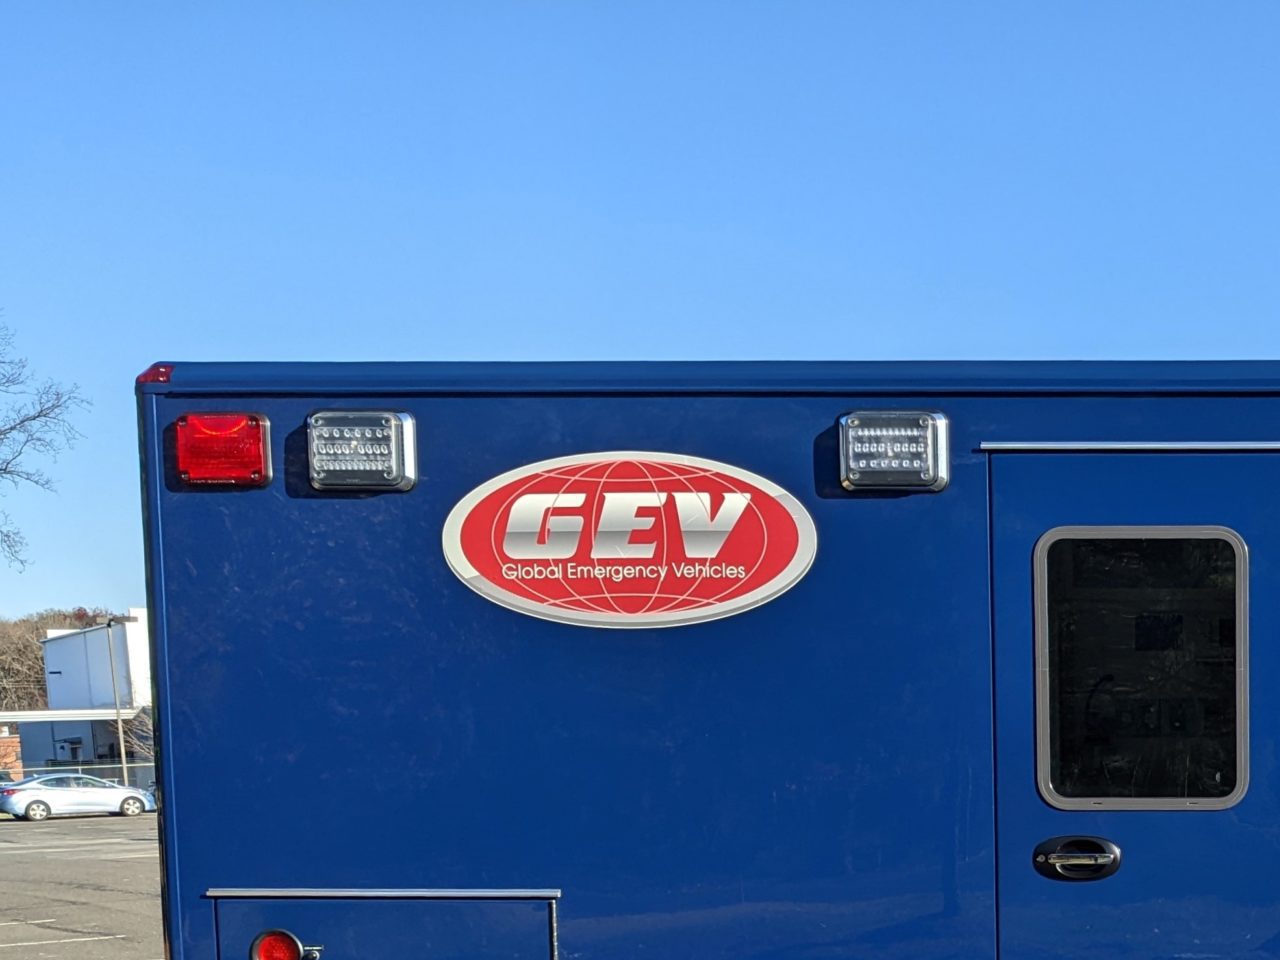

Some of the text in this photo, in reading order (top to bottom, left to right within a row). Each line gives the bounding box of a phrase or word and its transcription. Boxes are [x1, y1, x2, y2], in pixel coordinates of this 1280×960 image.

[502, 492, 751, 560] GEV
[501, 561, 746, 582] Global Emergency Vehicles
